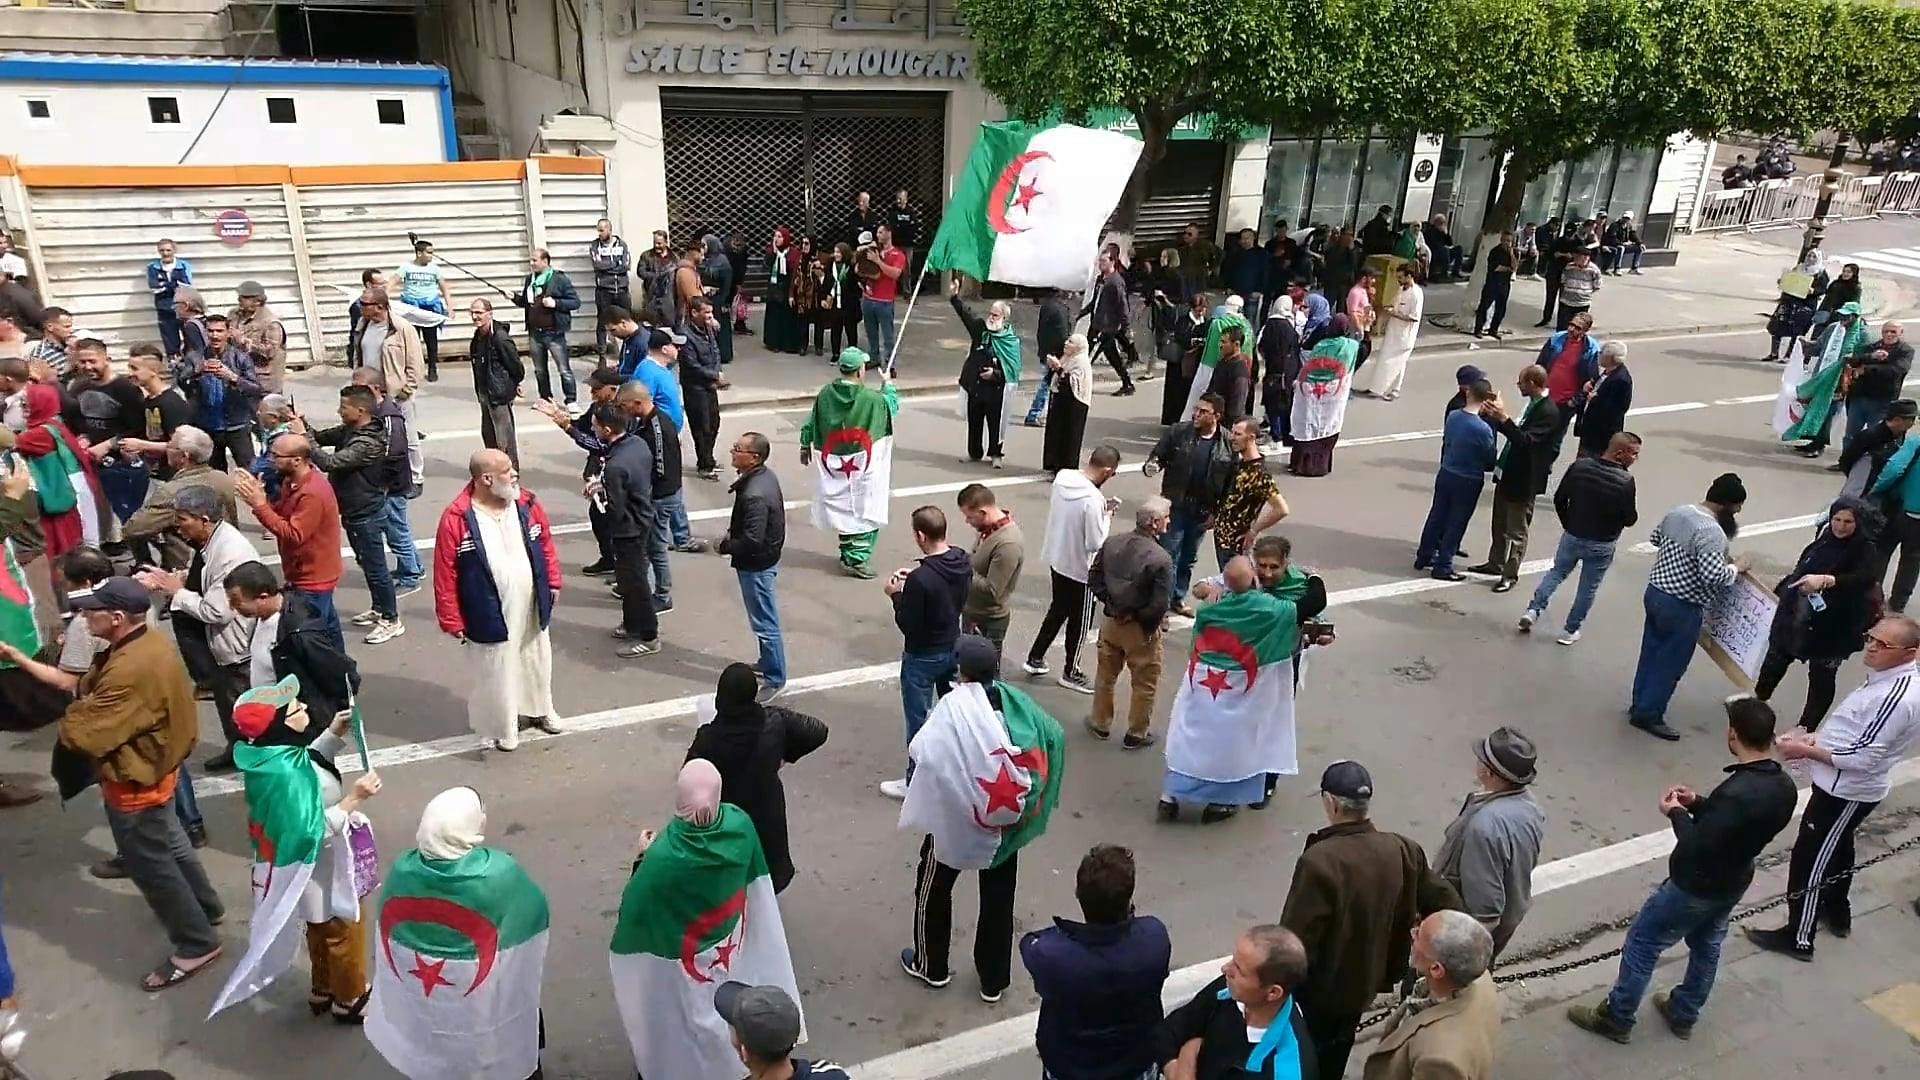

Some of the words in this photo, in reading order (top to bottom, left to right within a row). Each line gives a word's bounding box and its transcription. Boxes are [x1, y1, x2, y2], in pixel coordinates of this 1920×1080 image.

[625, 43, 746, 74] SALLE
[768, 46, 811, 76] EL
[826, 47, 969, 80] MOUGAR
